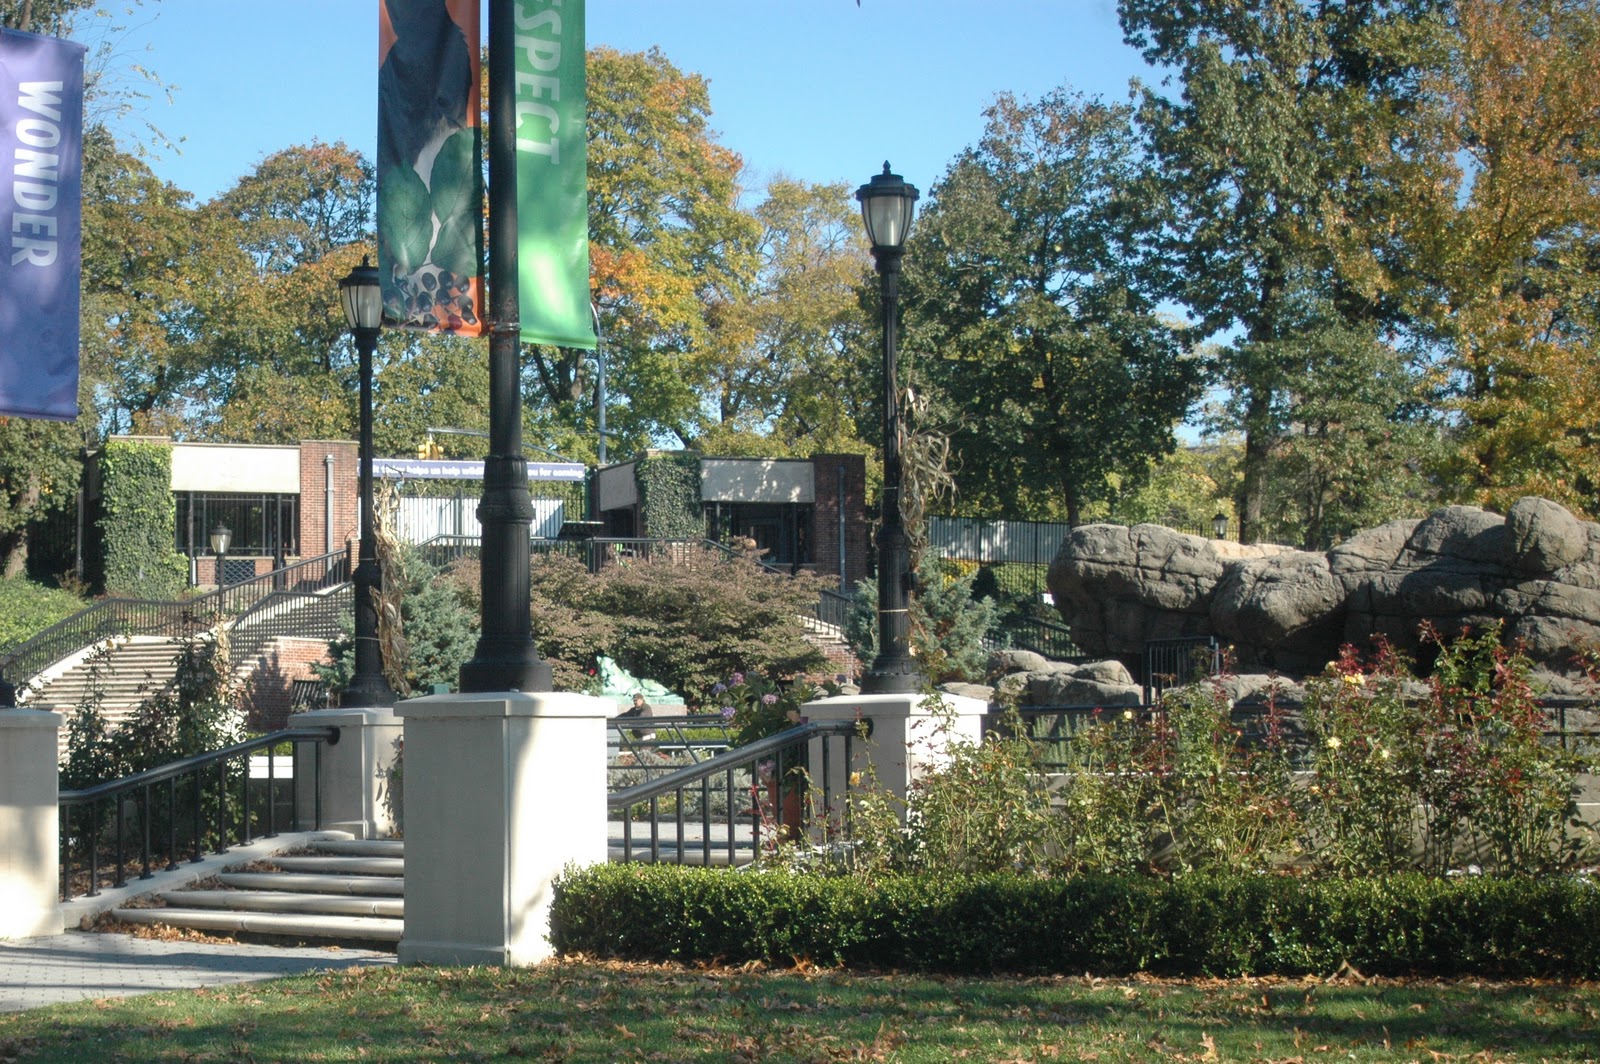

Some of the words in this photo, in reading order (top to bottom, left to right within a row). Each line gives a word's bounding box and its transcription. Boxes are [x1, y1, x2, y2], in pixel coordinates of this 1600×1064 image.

[514, 0, 562, 165] SPECT
[11, 80, 64, 267] WONDER
[540, 468, 552, 476] for
